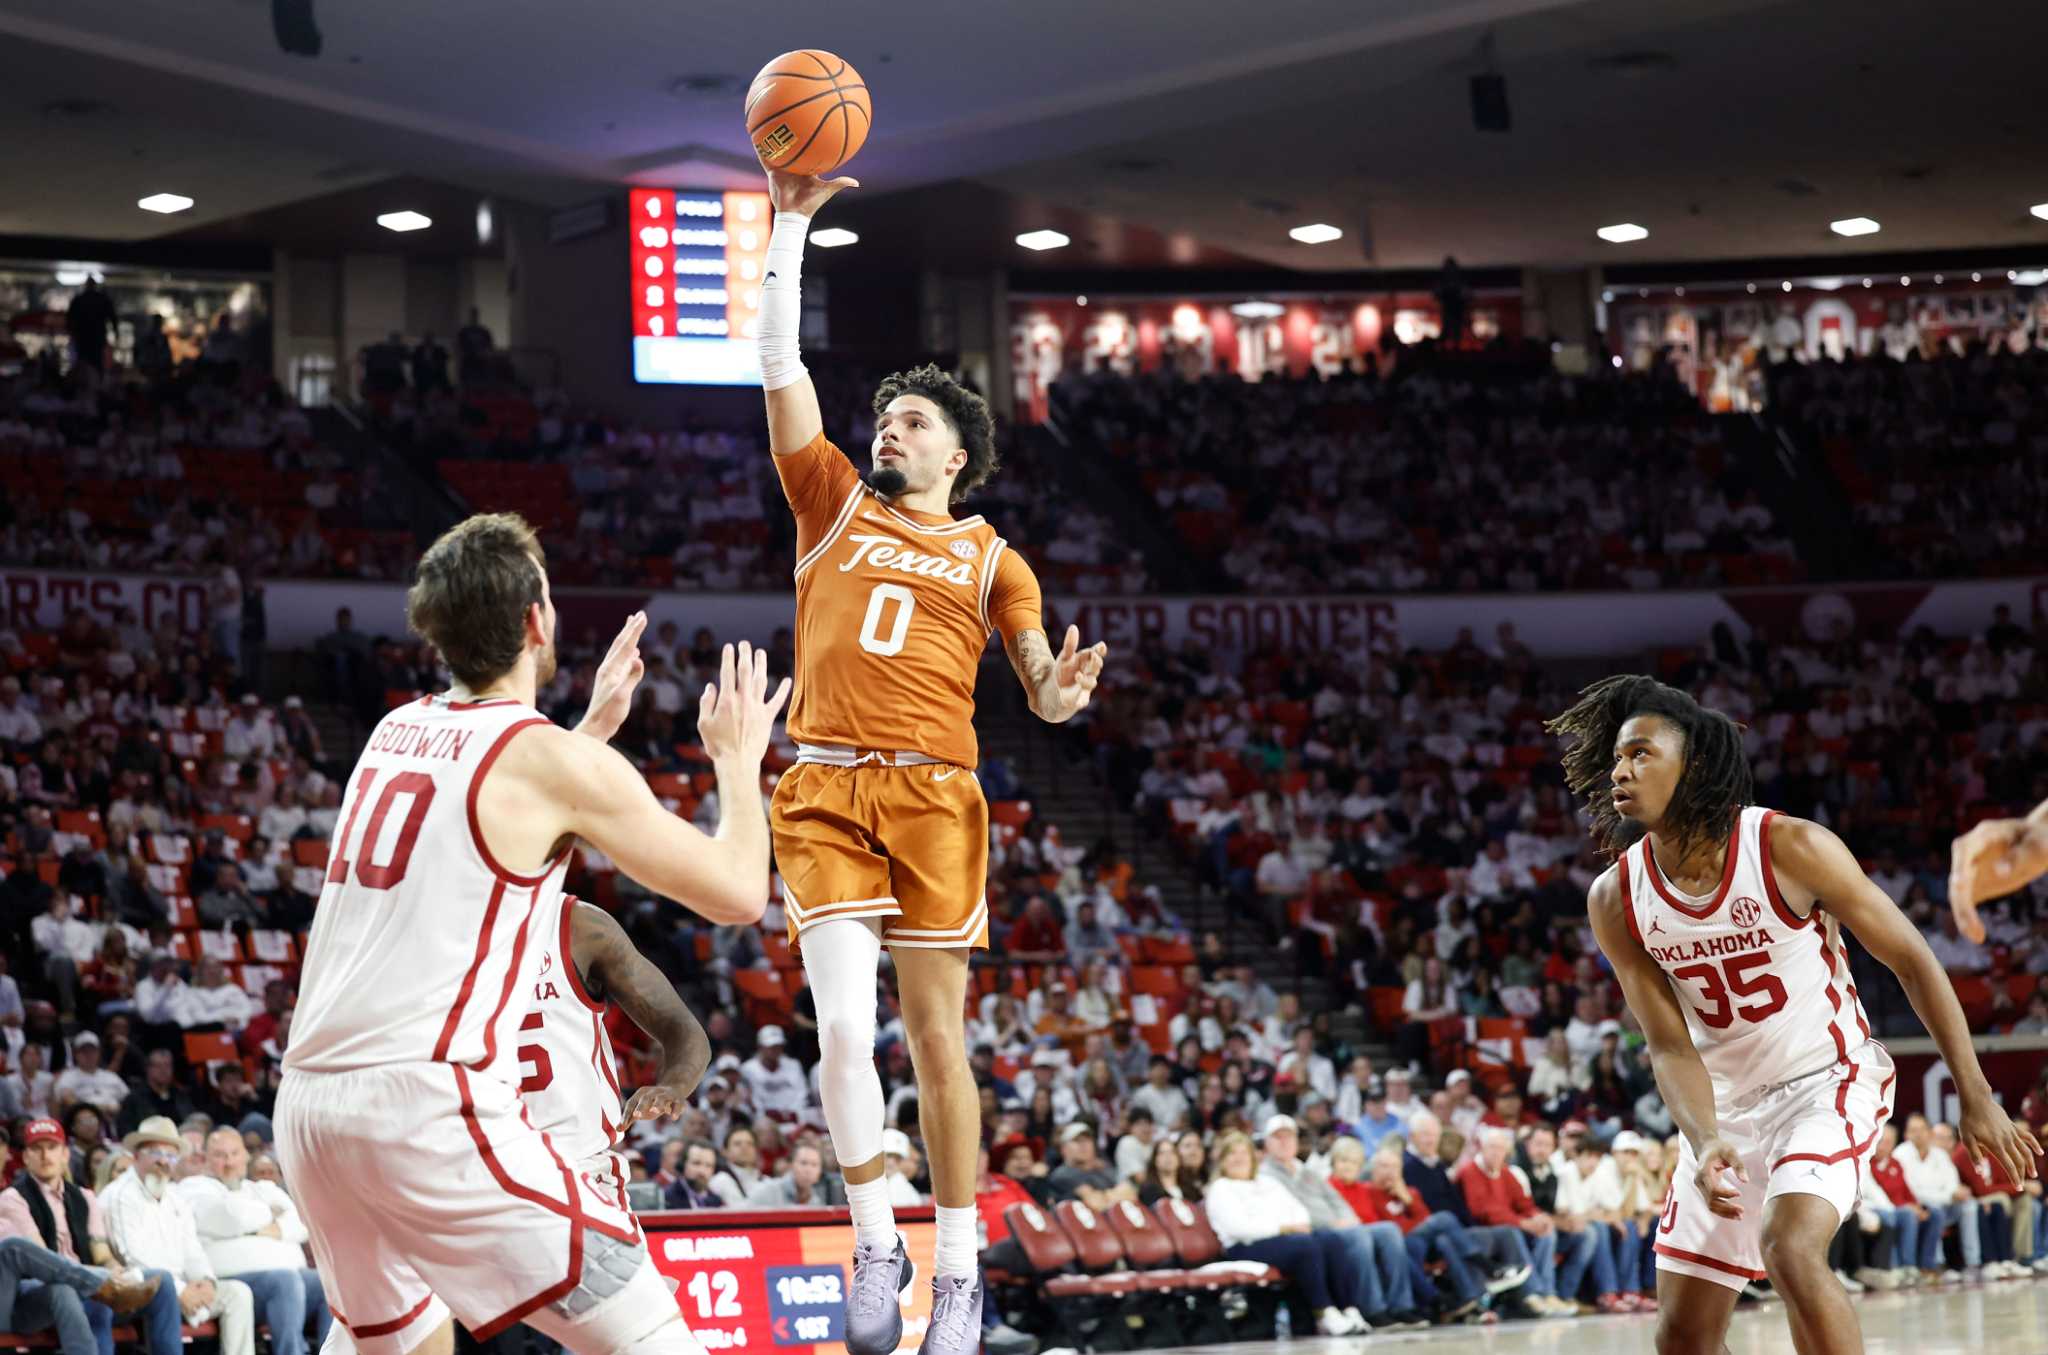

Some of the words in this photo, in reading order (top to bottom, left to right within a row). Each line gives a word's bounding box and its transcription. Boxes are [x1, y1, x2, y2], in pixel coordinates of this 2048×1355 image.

[839, 534, 974, 585] Texas
[858, 583, 916, 657] 0
[371, 721, 474, 761] GODWIN
[327, 767, 437, 891] 10
[1650, 928, 1776, 963] OKLAHOMA
[1672, 950, 1789, 1029] 35
[688, 1270, 742, 1318] 12
